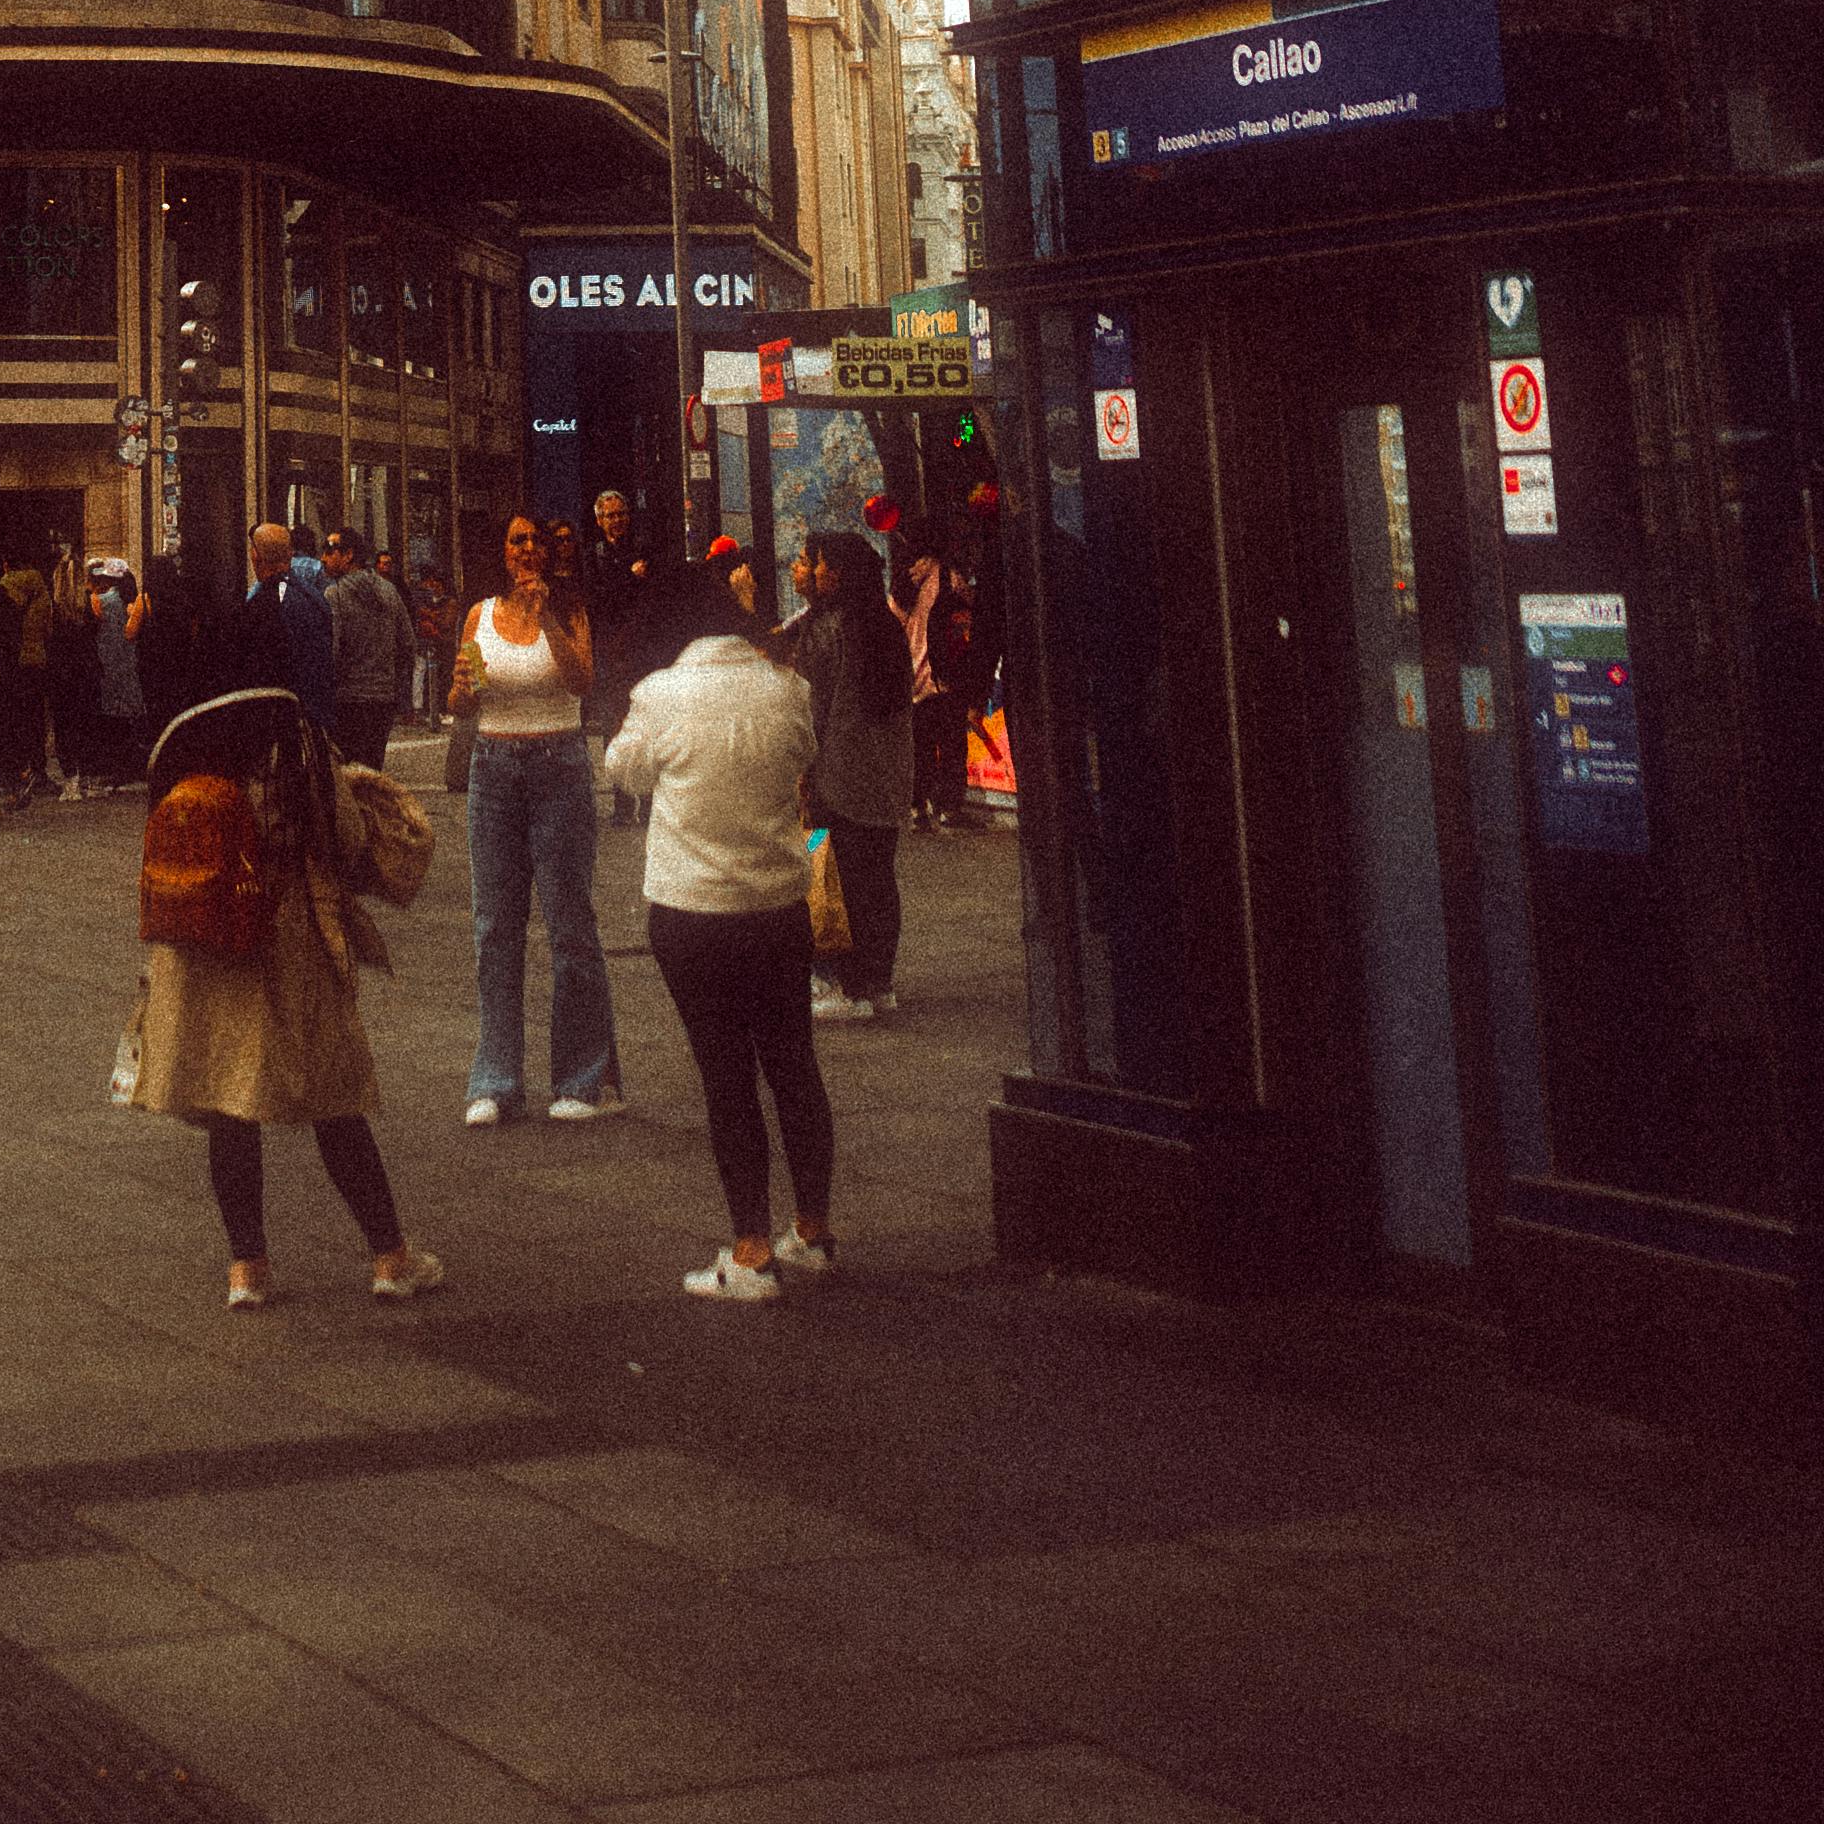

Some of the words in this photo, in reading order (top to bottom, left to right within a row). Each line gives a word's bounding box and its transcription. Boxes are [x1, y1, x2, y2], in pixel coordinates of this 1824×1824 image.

[1232, 38, 1322, 86] Callao
[1238, 120, 1270, 139] Plaza
[1272, 114, 1290, 133] del
[1292, 109, 1330, 129] Callao
[529, 273, 626, 308] OLES
[636, 273, 678, 307] AL
[836, 342, 914, 362] Bebidas
[837, 363, 969, 394] €0,50
[532, 418, 577, 435] Capitol
